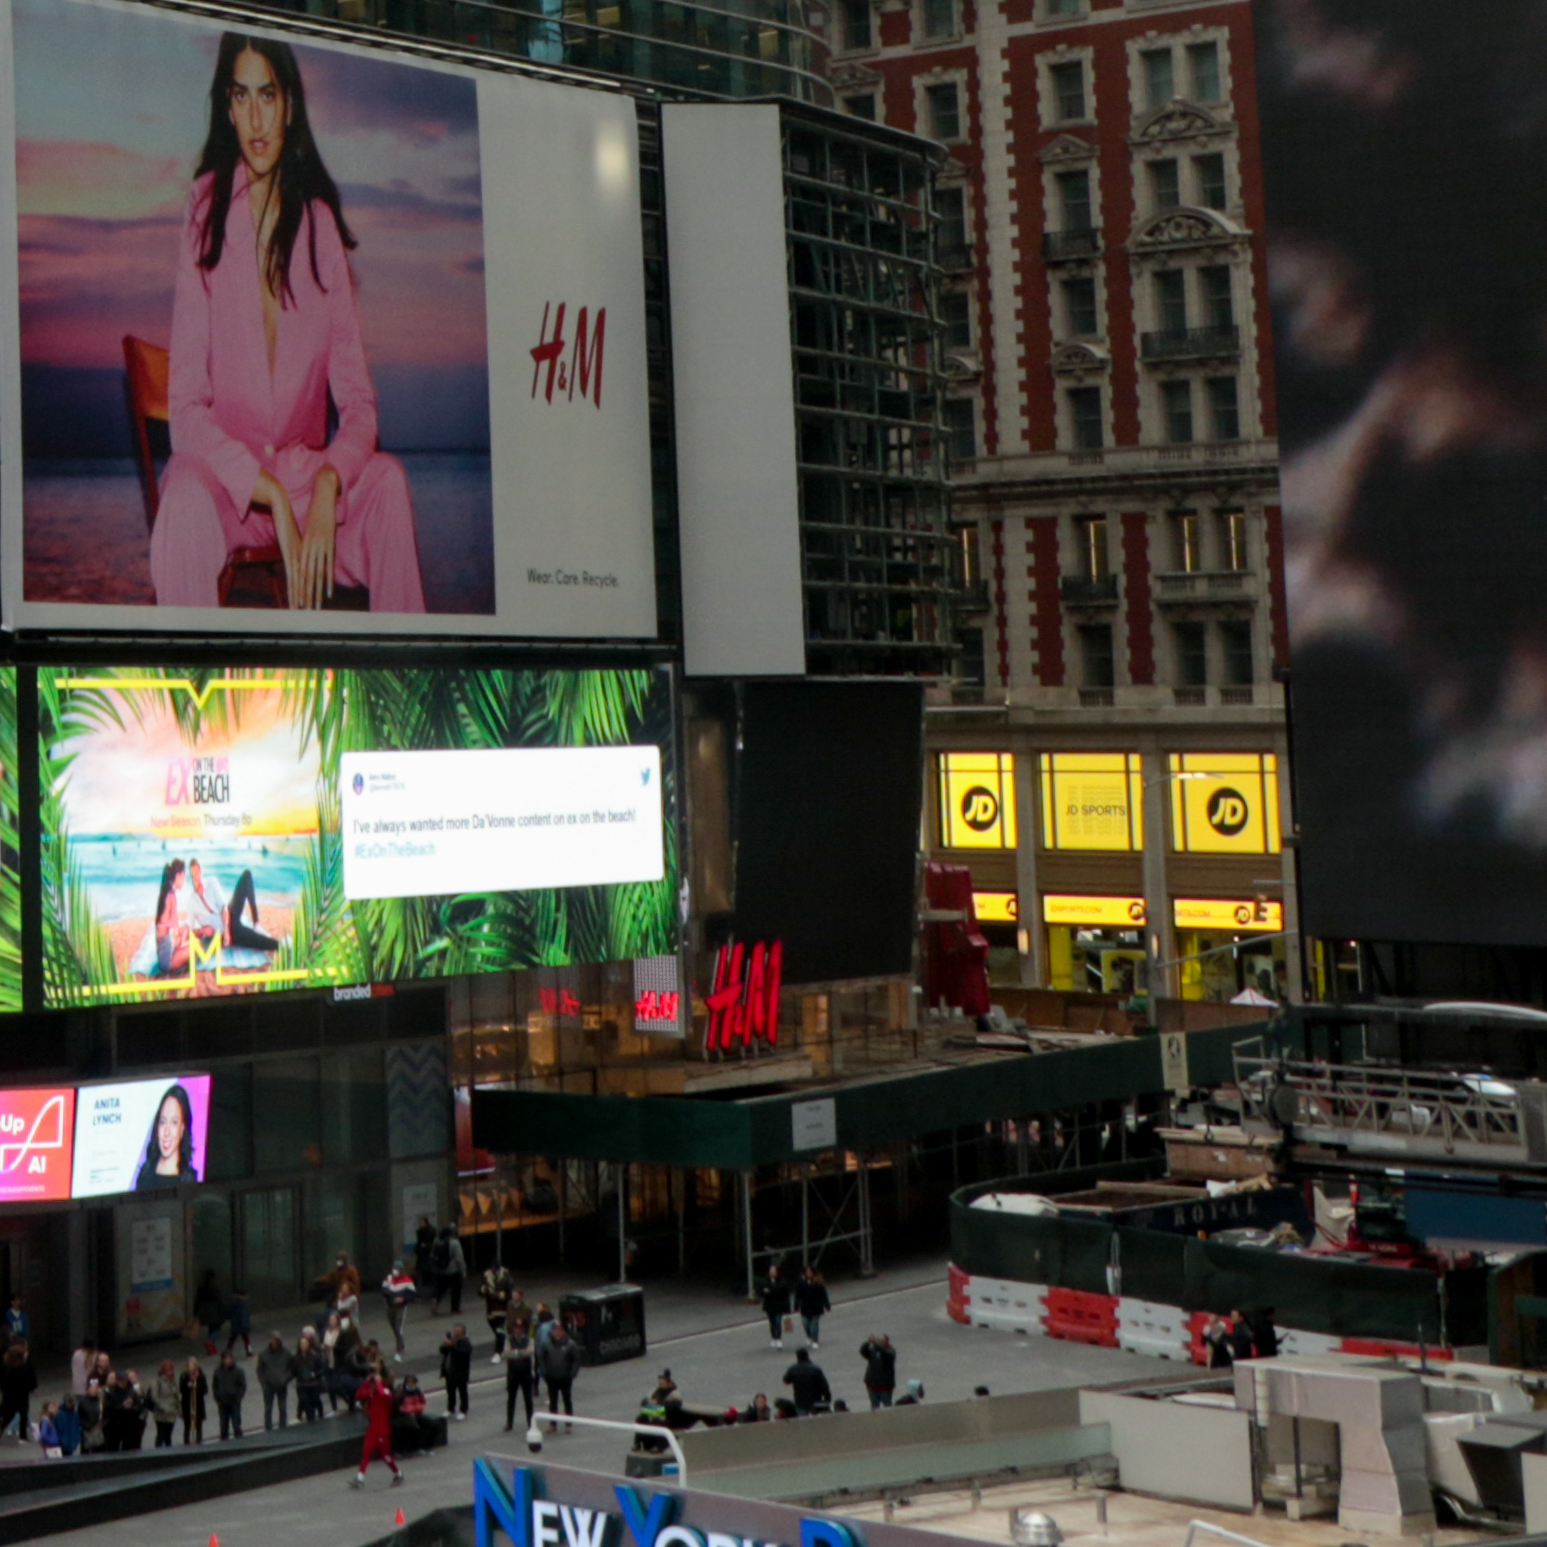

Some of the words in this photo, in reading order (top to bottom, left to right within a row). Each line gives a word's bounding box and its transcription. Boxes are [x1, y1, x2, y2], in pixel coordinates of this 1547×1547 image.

[529, 301, 606, 410] H&M
[527, 567, 554, 585] Wear.
[555, 569, 581, 586] Care.
[582, 570, 620, 589] Recycle.
[164, 758, 191, 805] EX
[193, 773, 230, 803] BEACH
[203, 813, 240, 828] Thursday
[964, 794, 997, 821] JD
[1066, 804, 1078, 816] JD
[1081, 804, 1126, 817] SPORTS
[1210, 796, 1246, 826] JD
[353, 819, 371, 834] I've
[373, 818, 407, 836] always
[409, 816, 444, 831] wanted
[446, 817, 470, 830] more
[517, 813, 552, 828] content
[553, 815, 565, 826] on
[566, 814, 577, 825] ex
[579, 813, 591, 824] on
[592, 810, 606, 824] the
[607, 808, 636, 824] beach!
[636, 990, 680, 1022] H&M
[704, 939, 783, 1051] H&M
[93, 1096, 121, 1110] ANITA
[92, 1112, 122, 1126] LYNCH
[28, 1155, 46, 1173] AI
[474, 1456, 608, 1547] NEW
